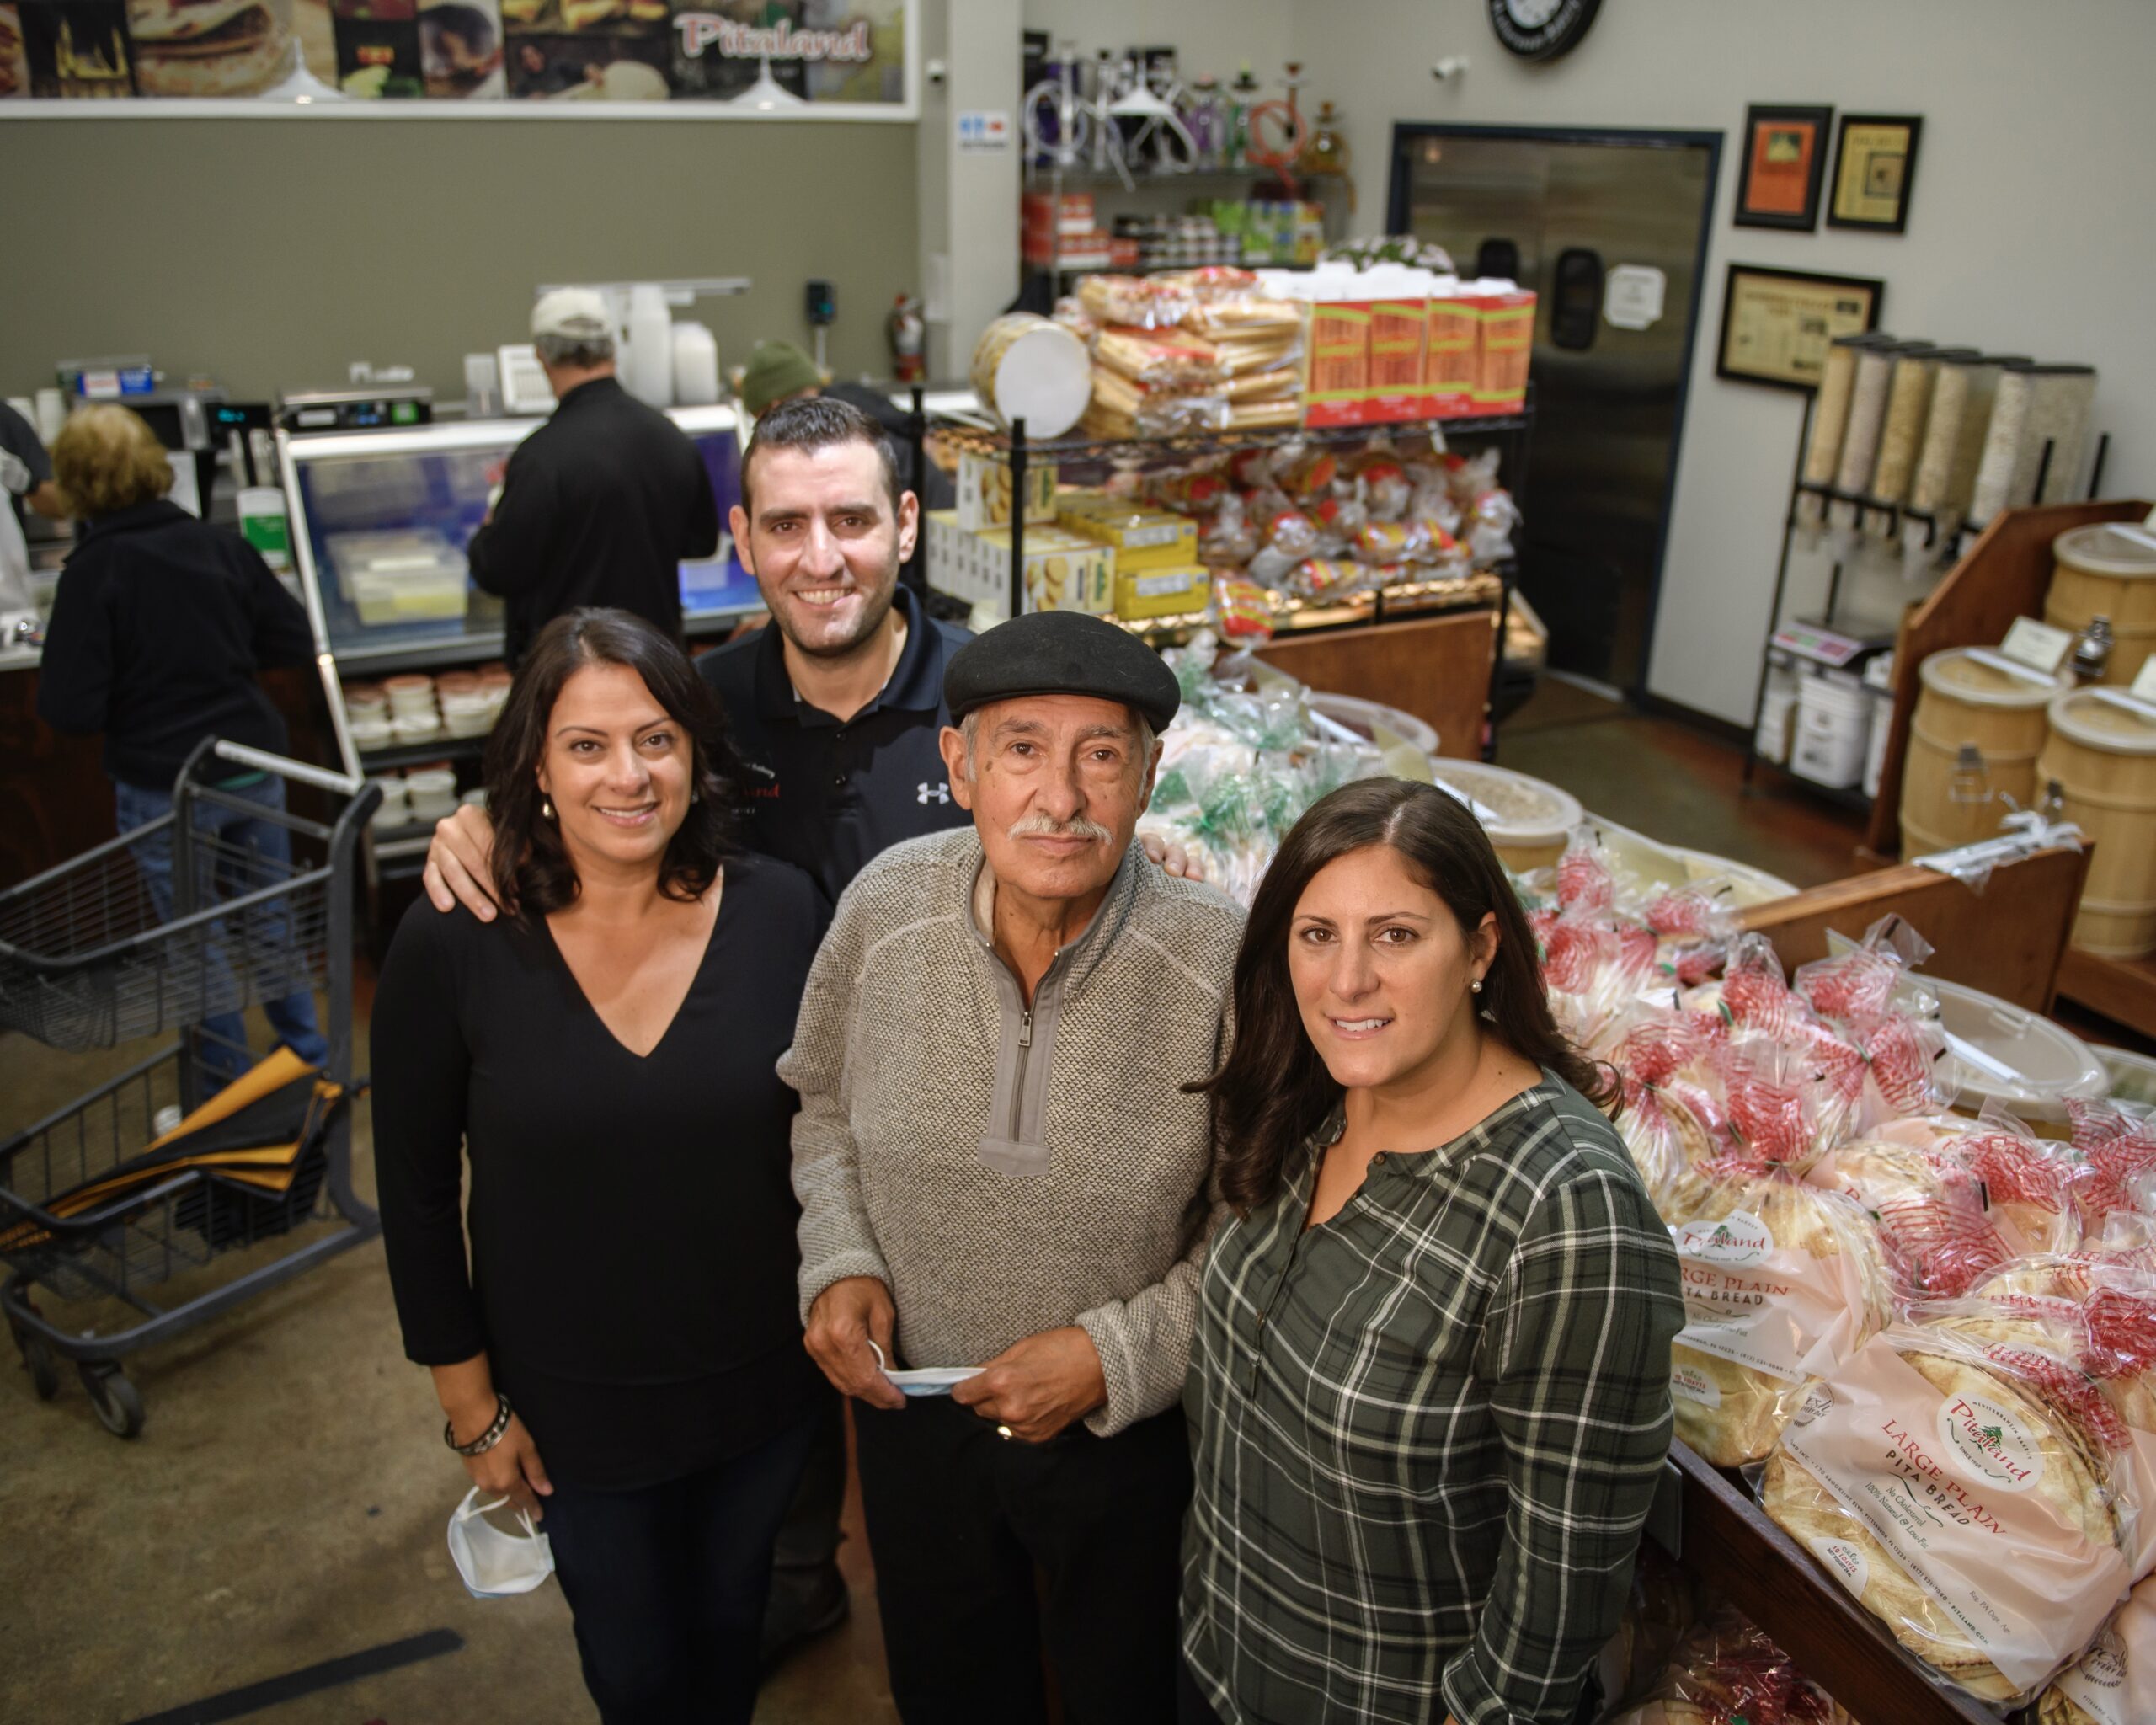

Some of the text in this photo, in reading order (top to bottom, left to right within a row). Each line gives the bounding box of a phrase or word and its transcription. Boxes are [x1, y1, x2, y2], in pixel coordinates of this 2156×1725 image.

[675, 13, 872, 62] Pitaland
[1681, 1266, 1790, 1296] RGE PLAIN
[1686, 1286, 1764, 1306] TA BREAD
[1972, 1401, 2019, 1434] MEDITERRANEAN
[1951, 1398, 2031, 1482] Pitaland
[1881, 1418, 2007, 1535] LARGE PLAIN
[1885, 1449, 1970, 1525] PITA BREAD
[1865, 1482, 1882, 1499] 100%
[1879, 1496, 1903, 1520] Natural
[1886, 1486, 1926, 1527] No Cholesterol
[1825, 1474, 1853, 1502] BROOKLINE
[1951, 1605, 1989, 1644] PITALAND.COM
[1838, 1553, 1858, 1573] LOAVES
[1980, 1601, 1988, 1612] PA
[2089, 1646, 2128, 1669] resh
